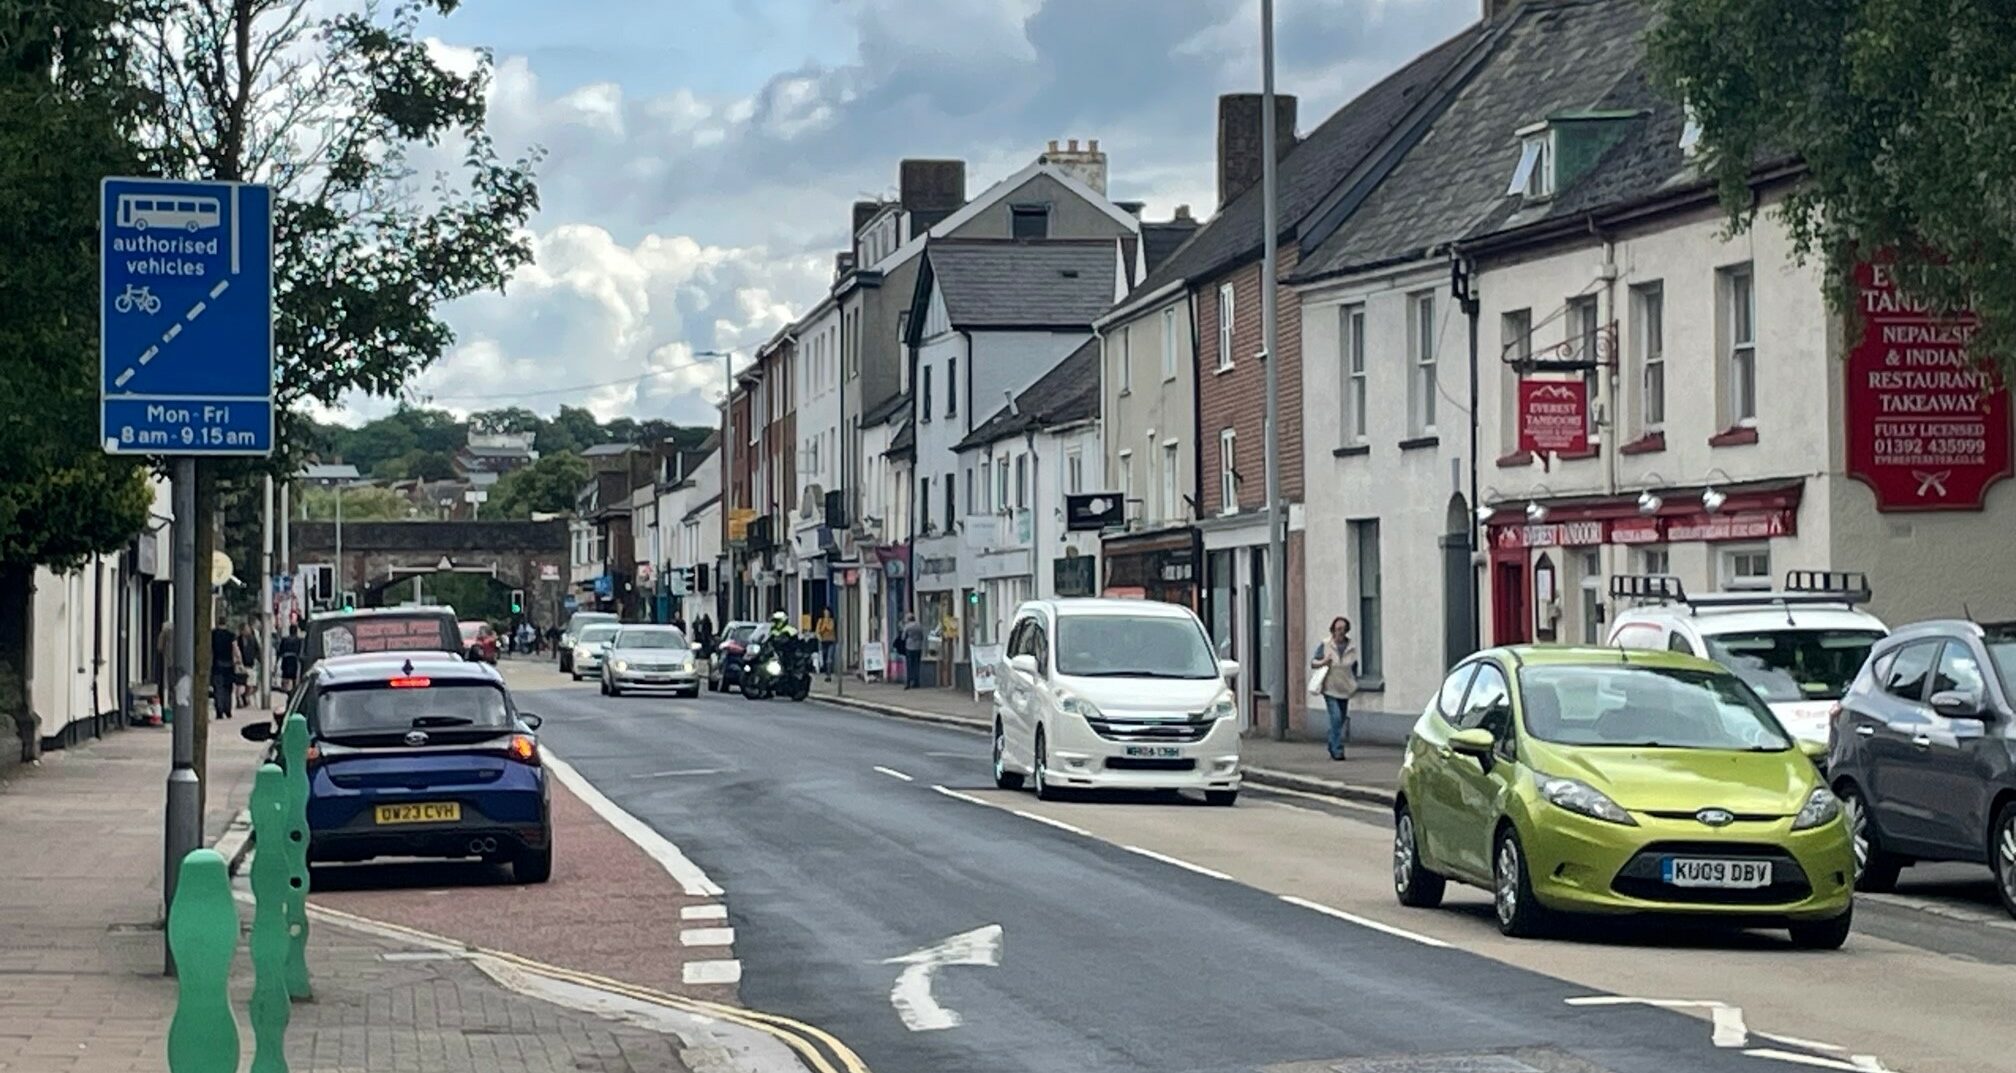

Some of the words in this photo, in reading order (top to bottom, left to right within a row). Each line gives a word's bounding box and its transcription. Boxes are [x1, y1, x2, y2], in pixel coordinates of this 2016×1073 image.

[113, 235, 217, 255] authorised
[126, 257, 205, 276] vehicles
[1885, 349, 1900, 366] &
[1906, 349, 1969, 367] INDIAN
[1868, 371, 1988, 389] RESTAURANT
[1879, 394, 1981, 412] TAKEAWAY
[147, 405, 190, 424] Mon
[203, 405, 229, 424] Fri
[1874, 423, 1917, 437] FULLY
[1920, 423, 1985, 437] LICENSED
[1874, 438, 1923, 454] 01392
[1927, 438, 1986, 454] 435999
[382, 804, 421, 820] DW23
[424, 804, 455, 819] CVH
[1675, 862, 1726, 881] KU09
[1730, 863, 1767, 882] DBV
